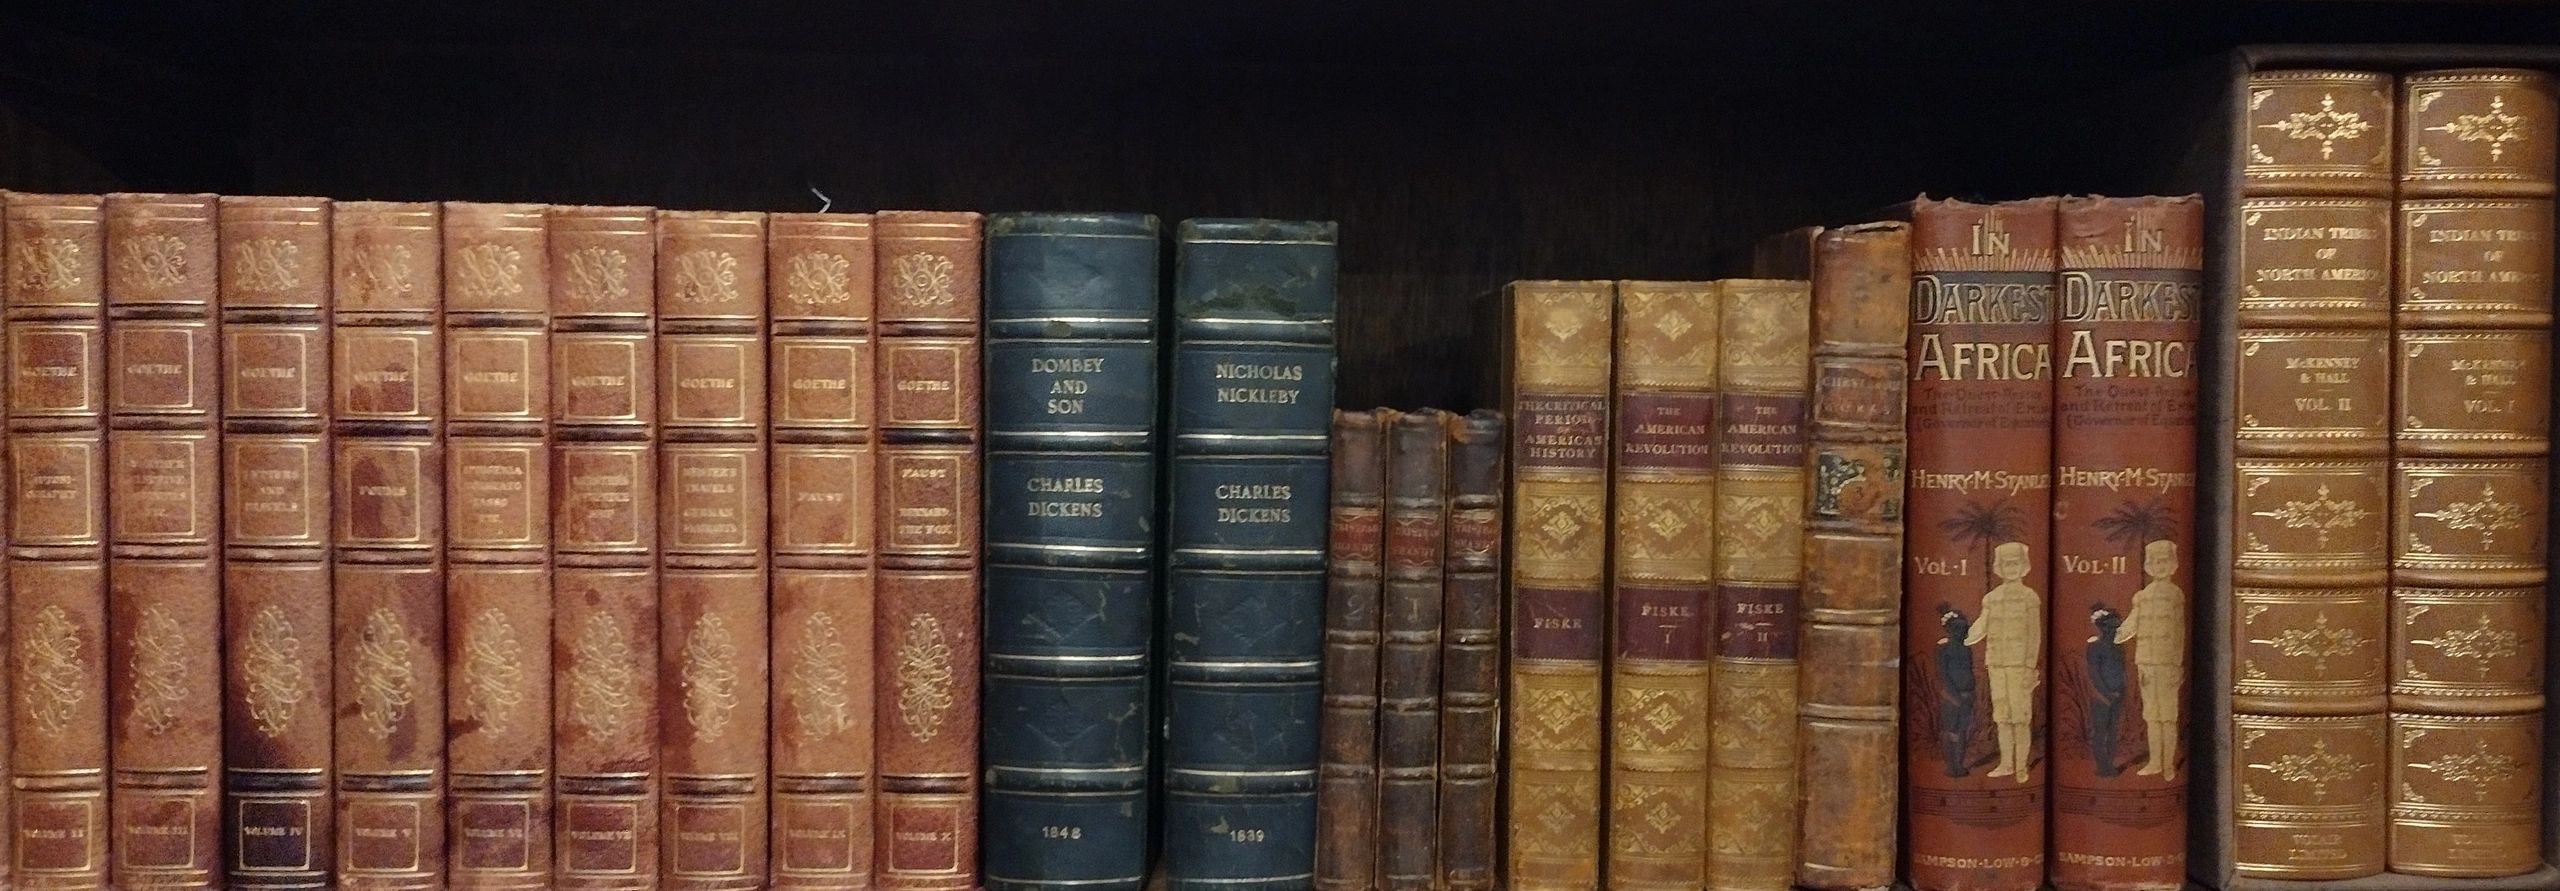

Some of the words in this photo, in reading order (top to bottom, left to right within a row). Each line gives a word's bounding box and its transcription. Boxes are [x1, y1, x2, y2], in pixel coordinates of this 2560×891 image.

[1971, 218, 2010, 256] IN
[2124, 215, 2163, 254] IN
[2264, 228, 2324, 241] INDIAN
[2429, 229, 2493, 243] INDIAN
[2315, 248, 2337, 261] OF
[2483, 250, 2504, 262] OF
[2256, 268, 2316, 281] NORTH
[2321, 268, 2379, 281] AMERIC
[2423, 271, 2482, 284] NORTH
[1915, 333, 2052, 381] AFRICA
[1032, 358, 1104, 373] DOMBEY
[1216, 363, 1303, 380] NICHOLAS
[464, 371, 518, 383] GOETHE
[572, 375, 625, 387] GOETHE
[2301, 373, 2312, 384] &
[2315, 373, 2350, 384] HALL
[680, 378, 734, 389] GOETHE
[793, 378, 846, 390] GOETHE
[897, 380, 950, 392] GOETHE
[1050, 380, 1088, 395] AND
[1217, 389, 1300, 405] NICKLEBY
[1048, 400, 1083, 415] SON
[1518, 401, 1544, 411] THE
[2338, 398, 2352, 411] II
[1657, 407, 1681, 416] THE
[1755, 407, 1777, 416] THE
[1635, 425, 1705, 435] AMERICAN
[1728, 425, 1797, 434] AMERICAN
[1525, 434, 1602, 446] AMERICAN
[1530, 447, 1596, 458] HISTORY
[1624, 443, 1708, 455] REVOLUTION
[1721, 443, 1802, 455] REVOLUTION
[902, 469, 947, 478] FAUST
[1027, 478, 1103, 493] CHARLES
[1995, 471, 2050, 496] STANLE
[798, 493, 842, 503] FAUST
[1215, 485, 1291, 501] CHARLES
[1028, 502, 1102, 518] DICKENS
[1217, 508, 1291, 523] DICKENS
[1641, 605, 1690, 617] FISKE
[1736, 603, 1784, 615] FISKE
[1533, 617, 1583, 629] FISKE
[1757, 632, 1768, 642] II
[1230, 830, 1265, 842] 1839
